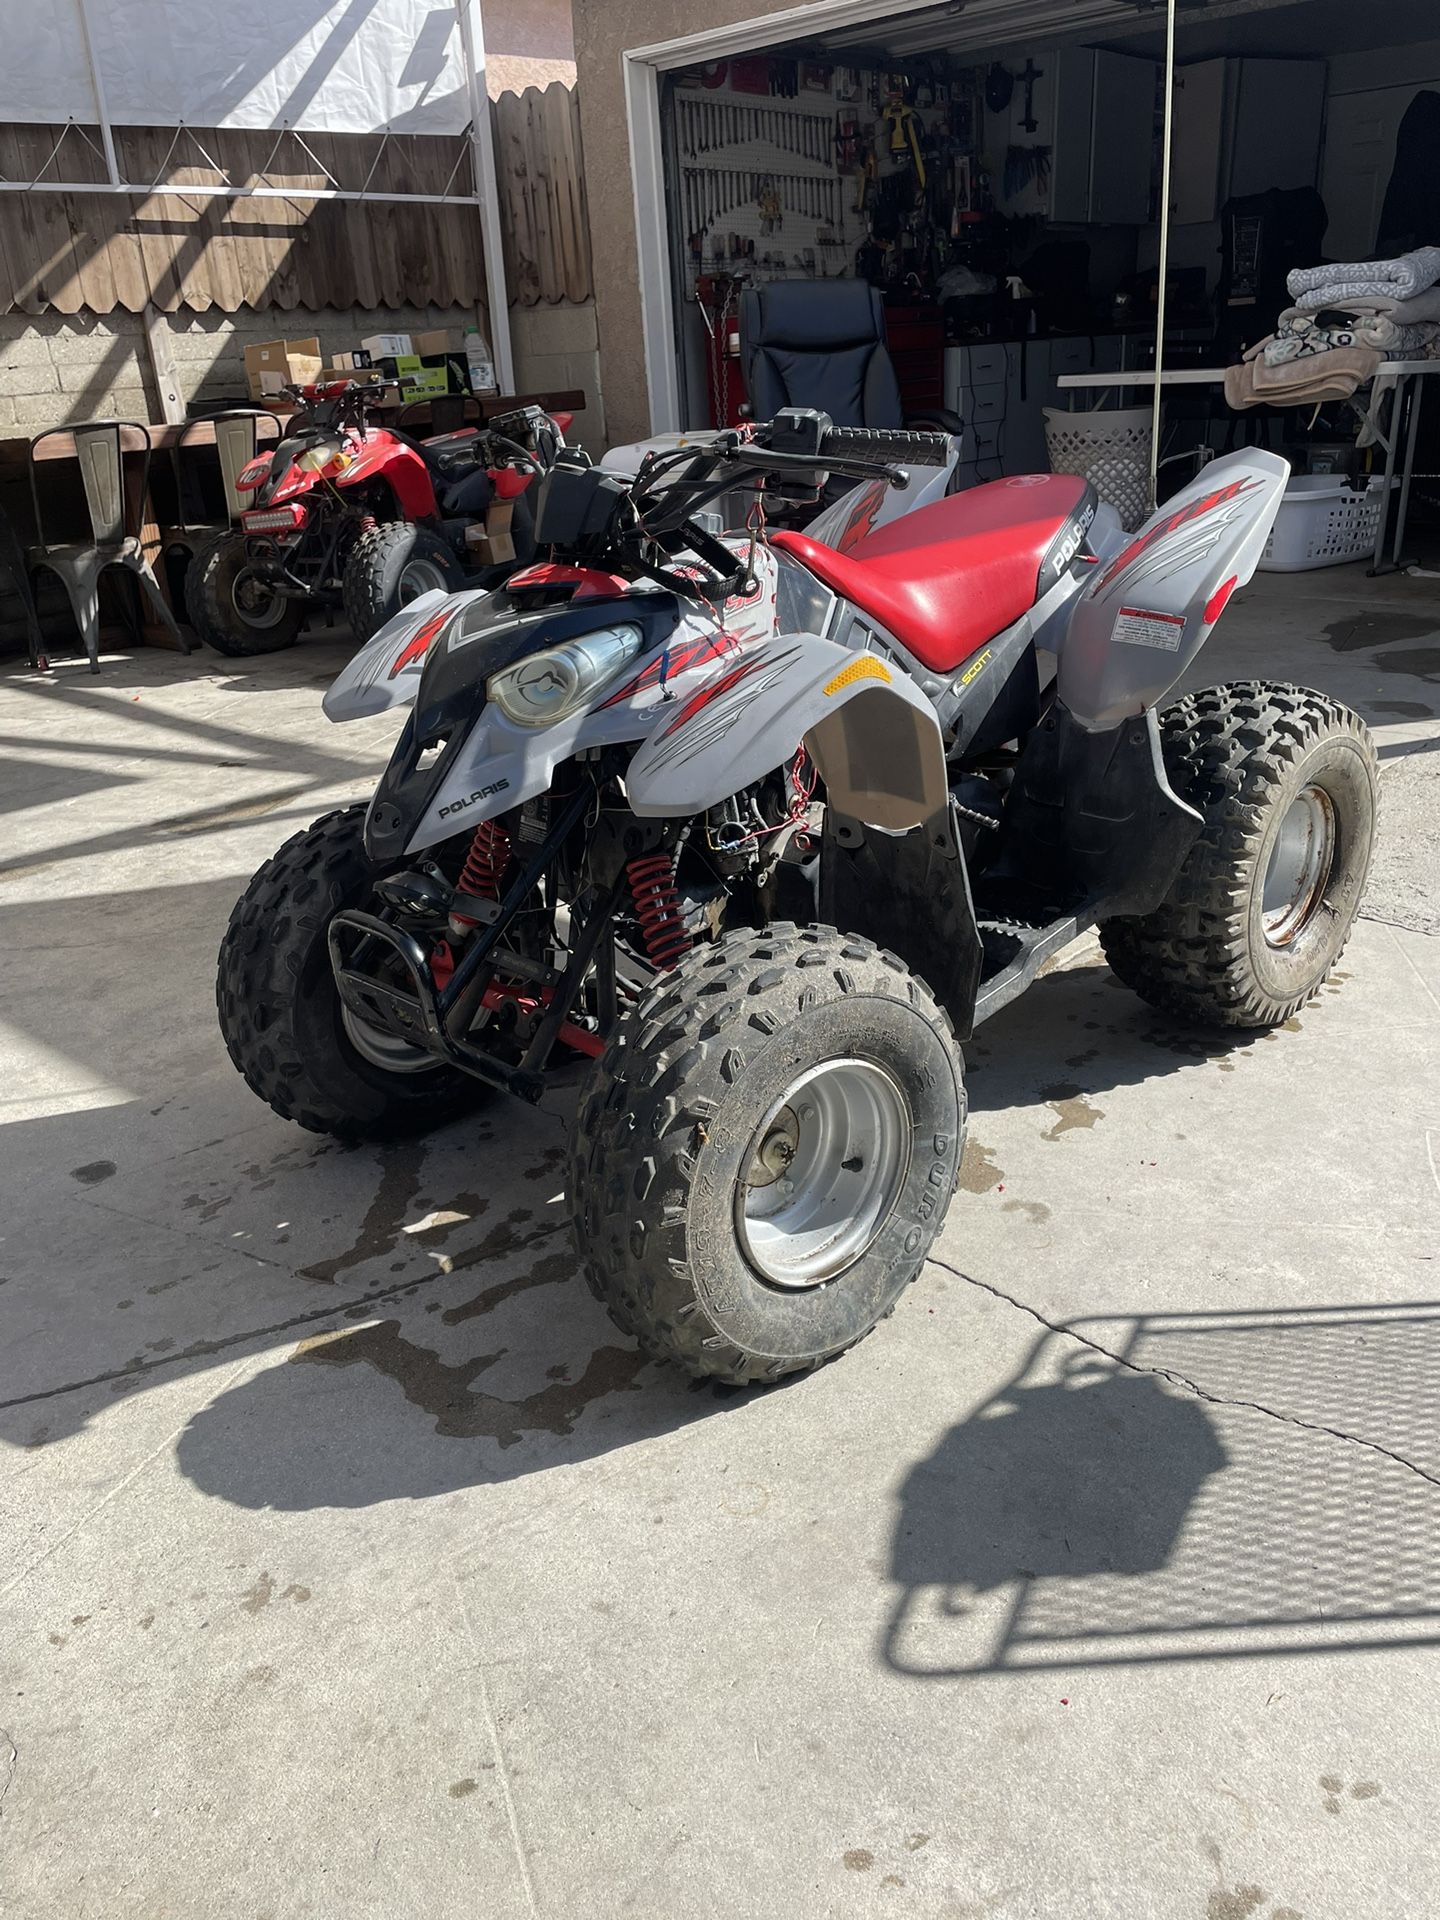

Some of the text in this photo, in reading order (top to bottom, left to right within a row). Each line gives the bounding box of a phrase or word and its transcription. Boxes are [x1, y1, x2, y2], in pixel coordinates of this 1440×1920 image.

[1051, 504, 1095, 577] POLARIS
[961, 649, 992, 685] SCOTT
[438, 778, 510, 819] POLARIS
[904, 1134, 949, 1254] DURO
